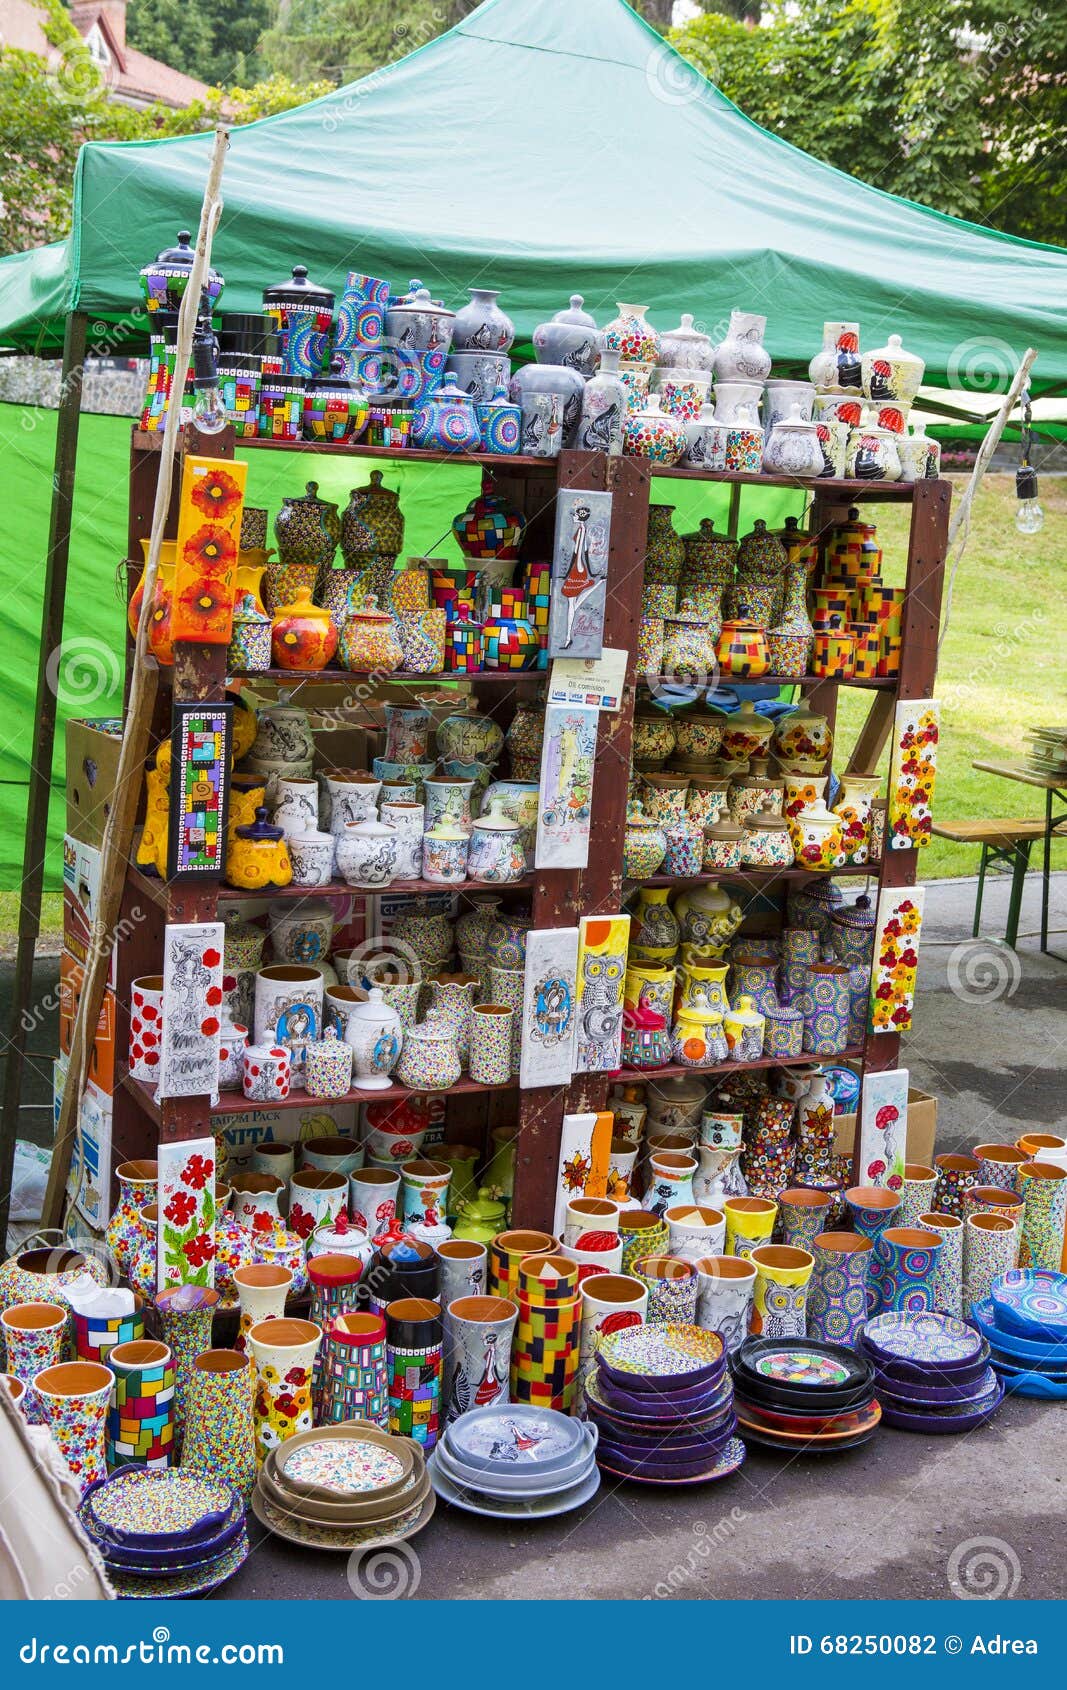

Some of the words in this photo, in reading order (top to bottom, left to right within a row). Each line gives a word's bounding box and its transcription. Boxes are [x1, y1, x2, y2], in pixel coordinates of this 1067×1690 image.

[210, 1113, 248, 1125] EMIUM
[224, 1126, 274, 1146] NITA
[424, 1134, 442, 1142] TRA
